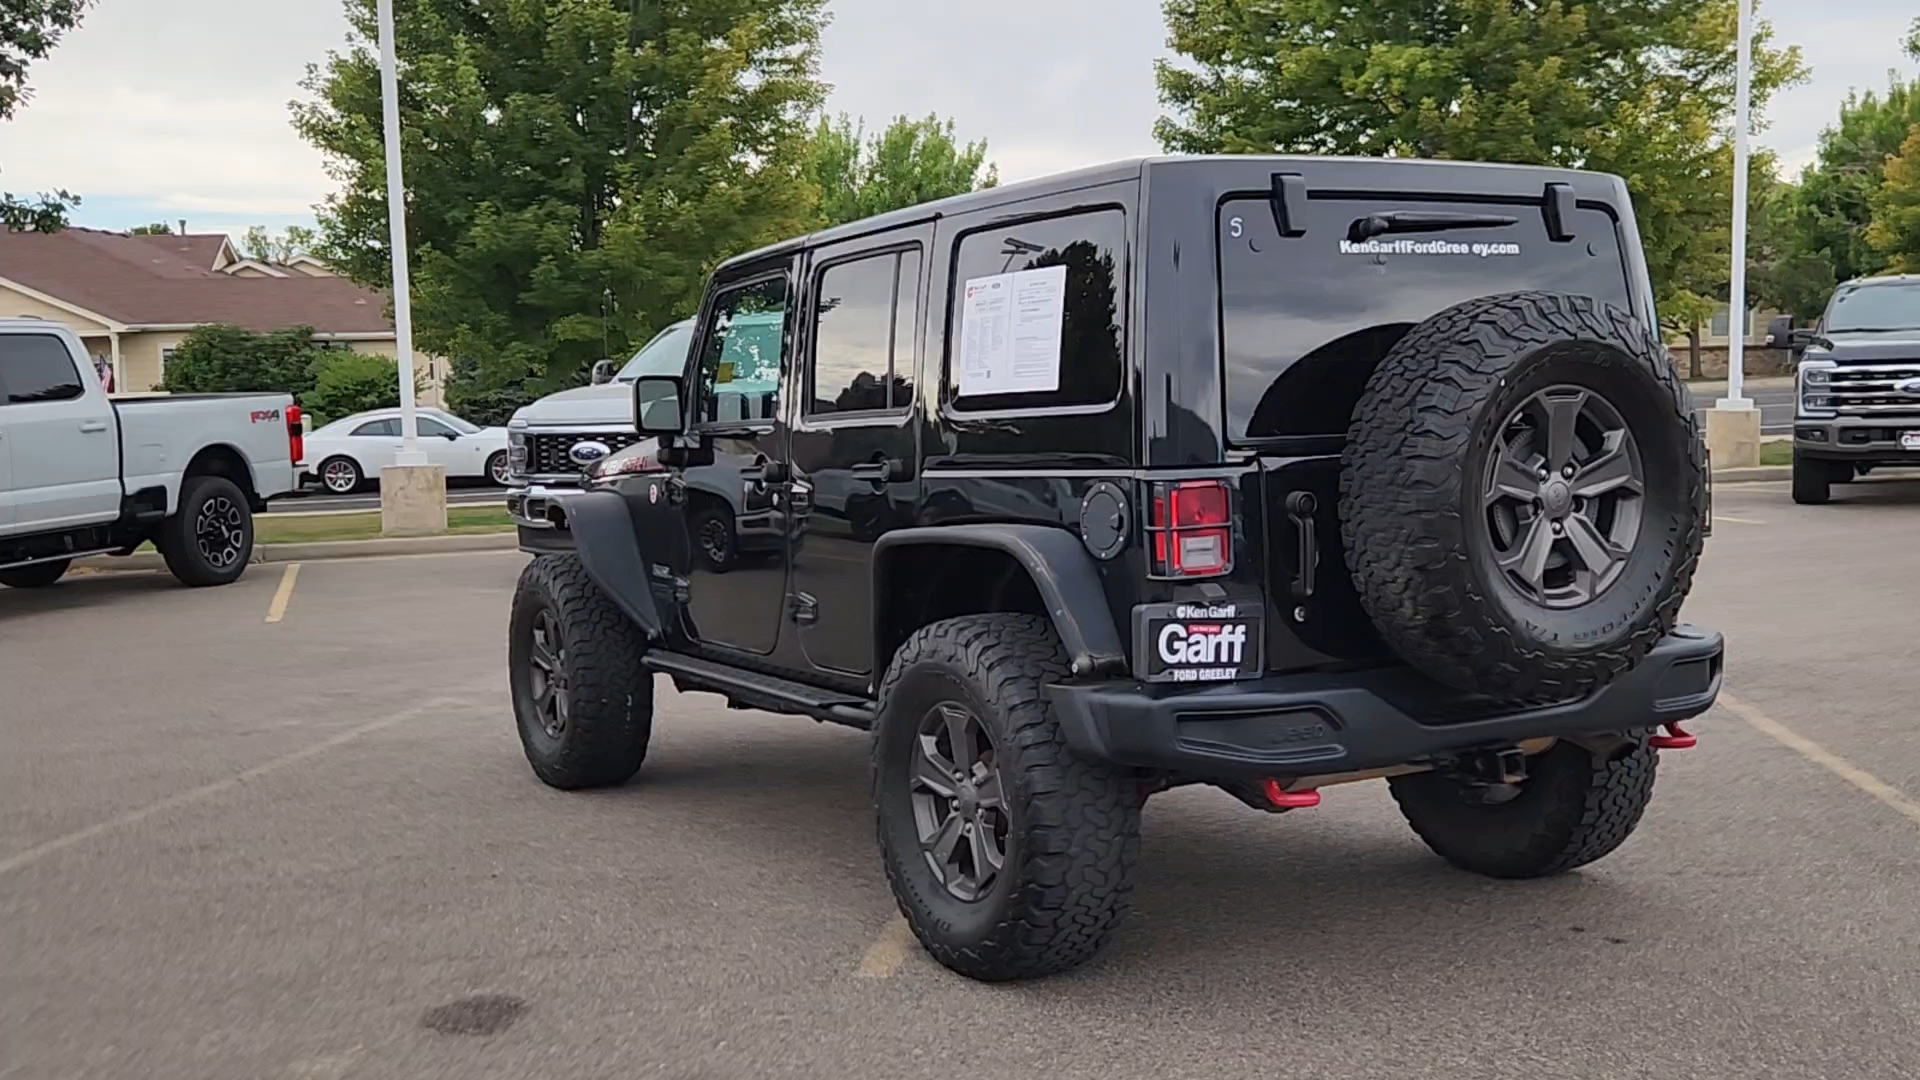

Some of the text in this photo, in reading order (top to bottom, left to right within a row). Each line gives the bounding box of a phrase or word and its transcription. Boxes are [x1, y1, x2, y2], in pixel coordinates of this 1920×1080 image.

[250, 409, 280, 424] FX4
[1186, 605, 1236, 618] Ken Garff
[1158, 623, 1246, 664] Garff
[1174, 668, 1237, 681] FORD GREELEY
